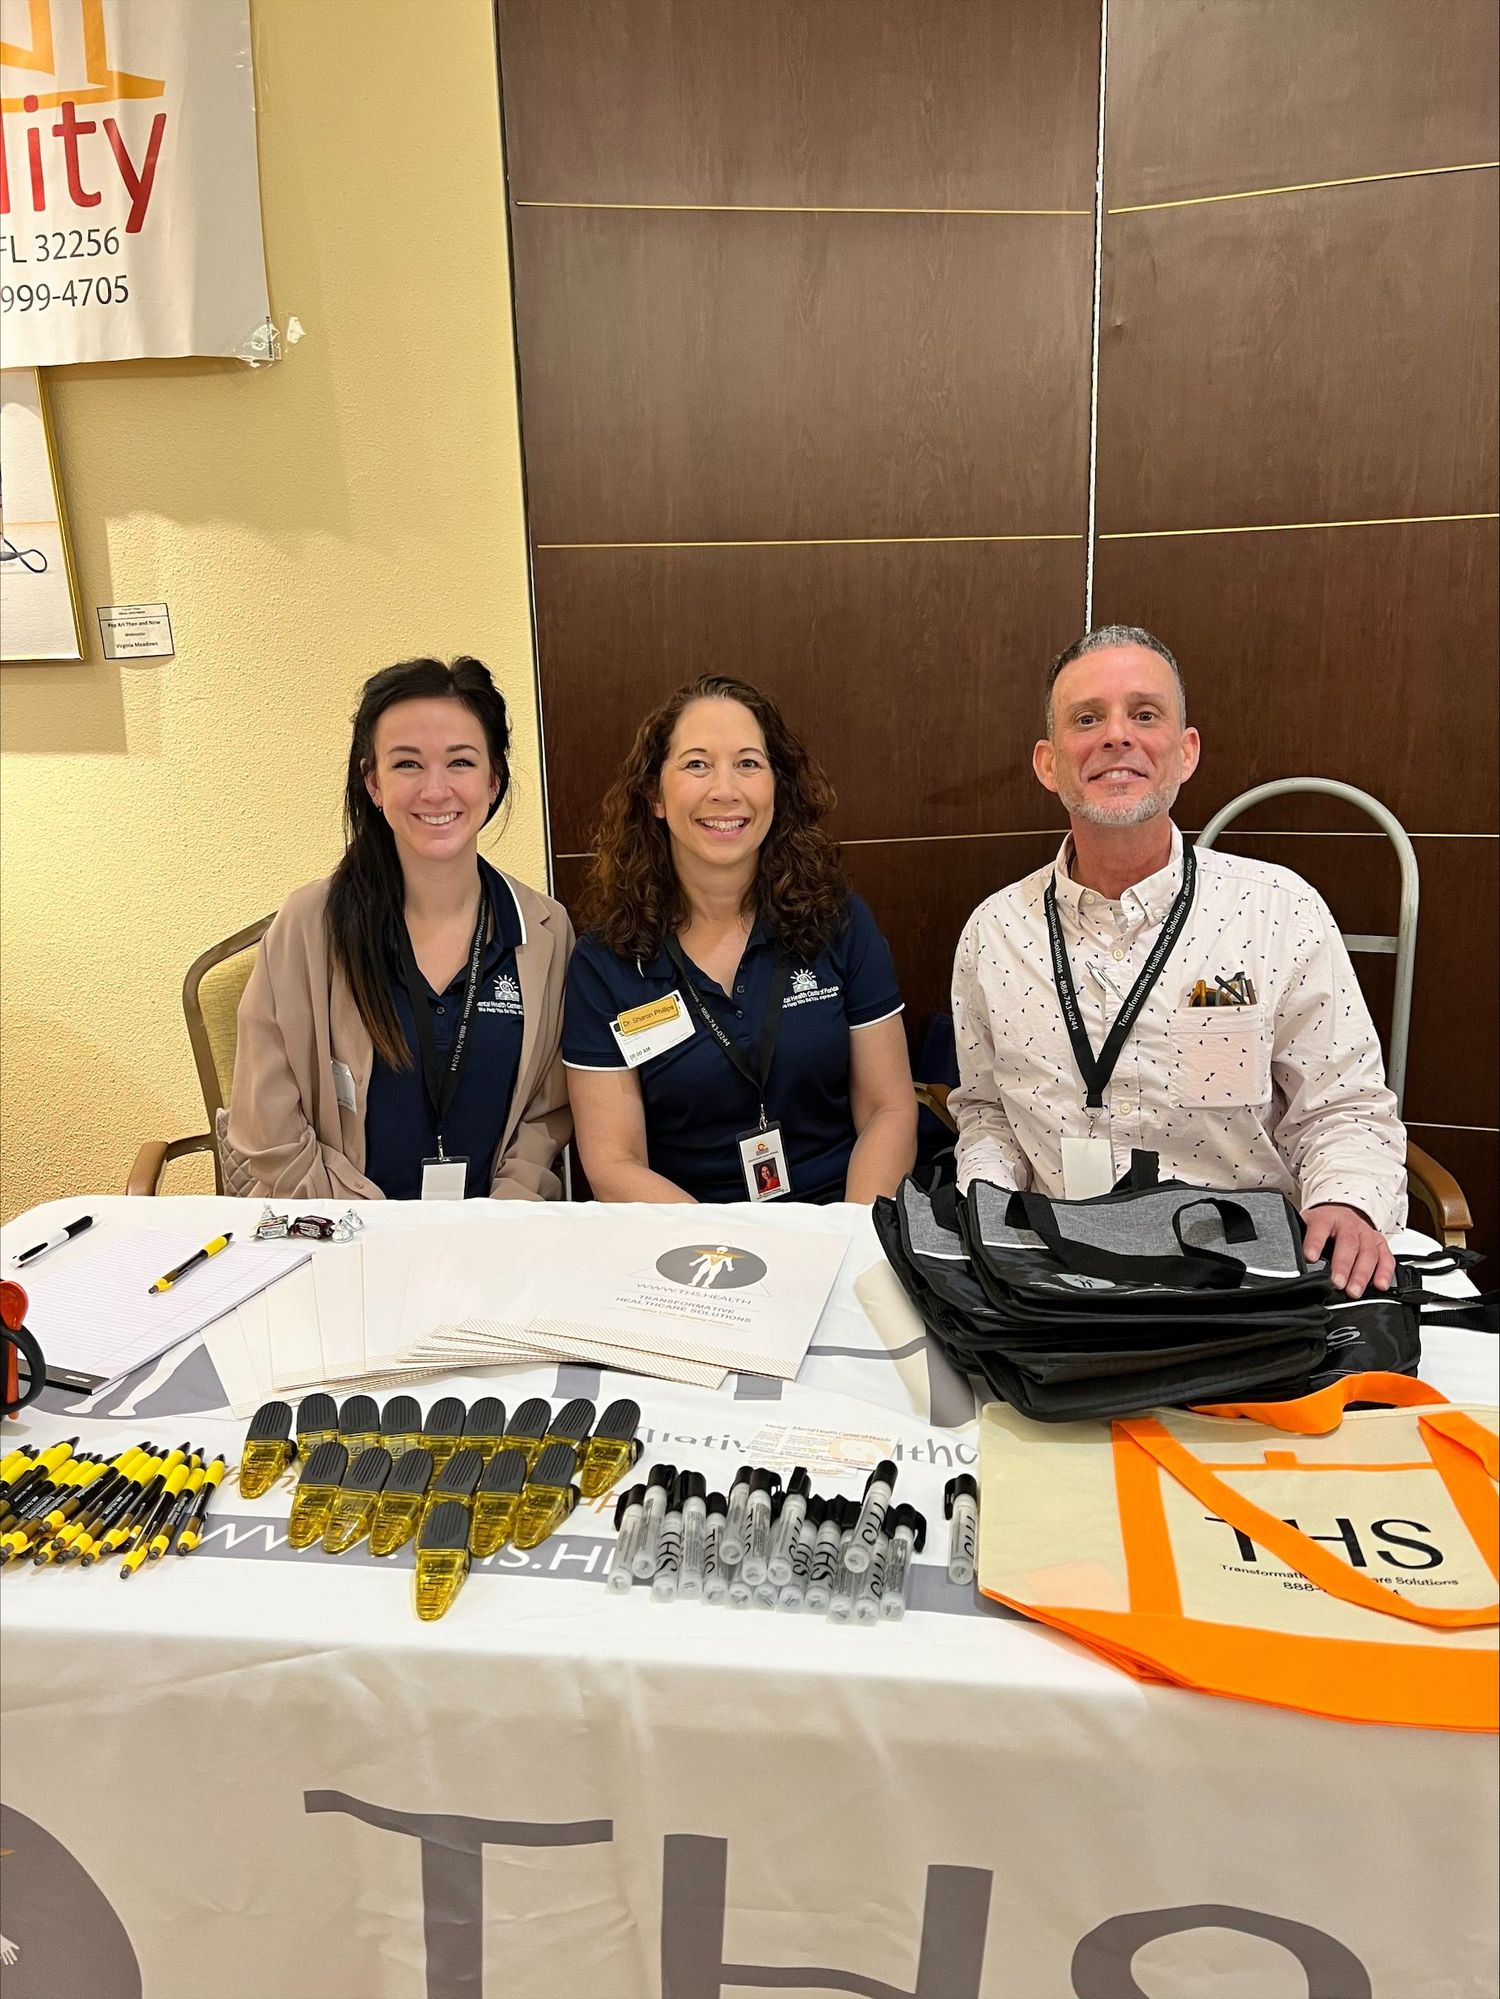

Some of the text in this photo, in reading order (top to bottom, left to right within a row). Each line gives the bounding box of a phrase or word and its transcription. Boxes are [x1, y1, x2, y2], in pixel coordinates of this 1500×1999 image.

[35, 226, 120, 262] 32256
[1, 275, 129, 312] 999-4705
[470, 947, 481, 984] Healthcare
[1118, 973, 1151, 1027] Transformative
[1147, 934, 1172, 974] Healthcare
[1166, 900, 1187, 935] Solutions
[463, 984, 477, 1019] Solutions
[1053, 939, 1064, 974] Solutions
[1060, 979, 1079, 1031] 888-743-0244
[633, 1012, 654, 1024] Sharon
[654, 1005, 675, 1016] Phillips
[700, 1006, 731, 1047] 888-743-0244
[450, 1025, 467, 1071] 888-743-0244
[616, 1297, 687, 1311] HEALTHCARE
[690, 1308, 752, 1323] SOLUTIONS
[639, 1295, 735, 1314] TRANSFORMATIVE
[1204, 1517, 1444, 1570] THS
[1395, 1577, 1459, 1586] Solutions
